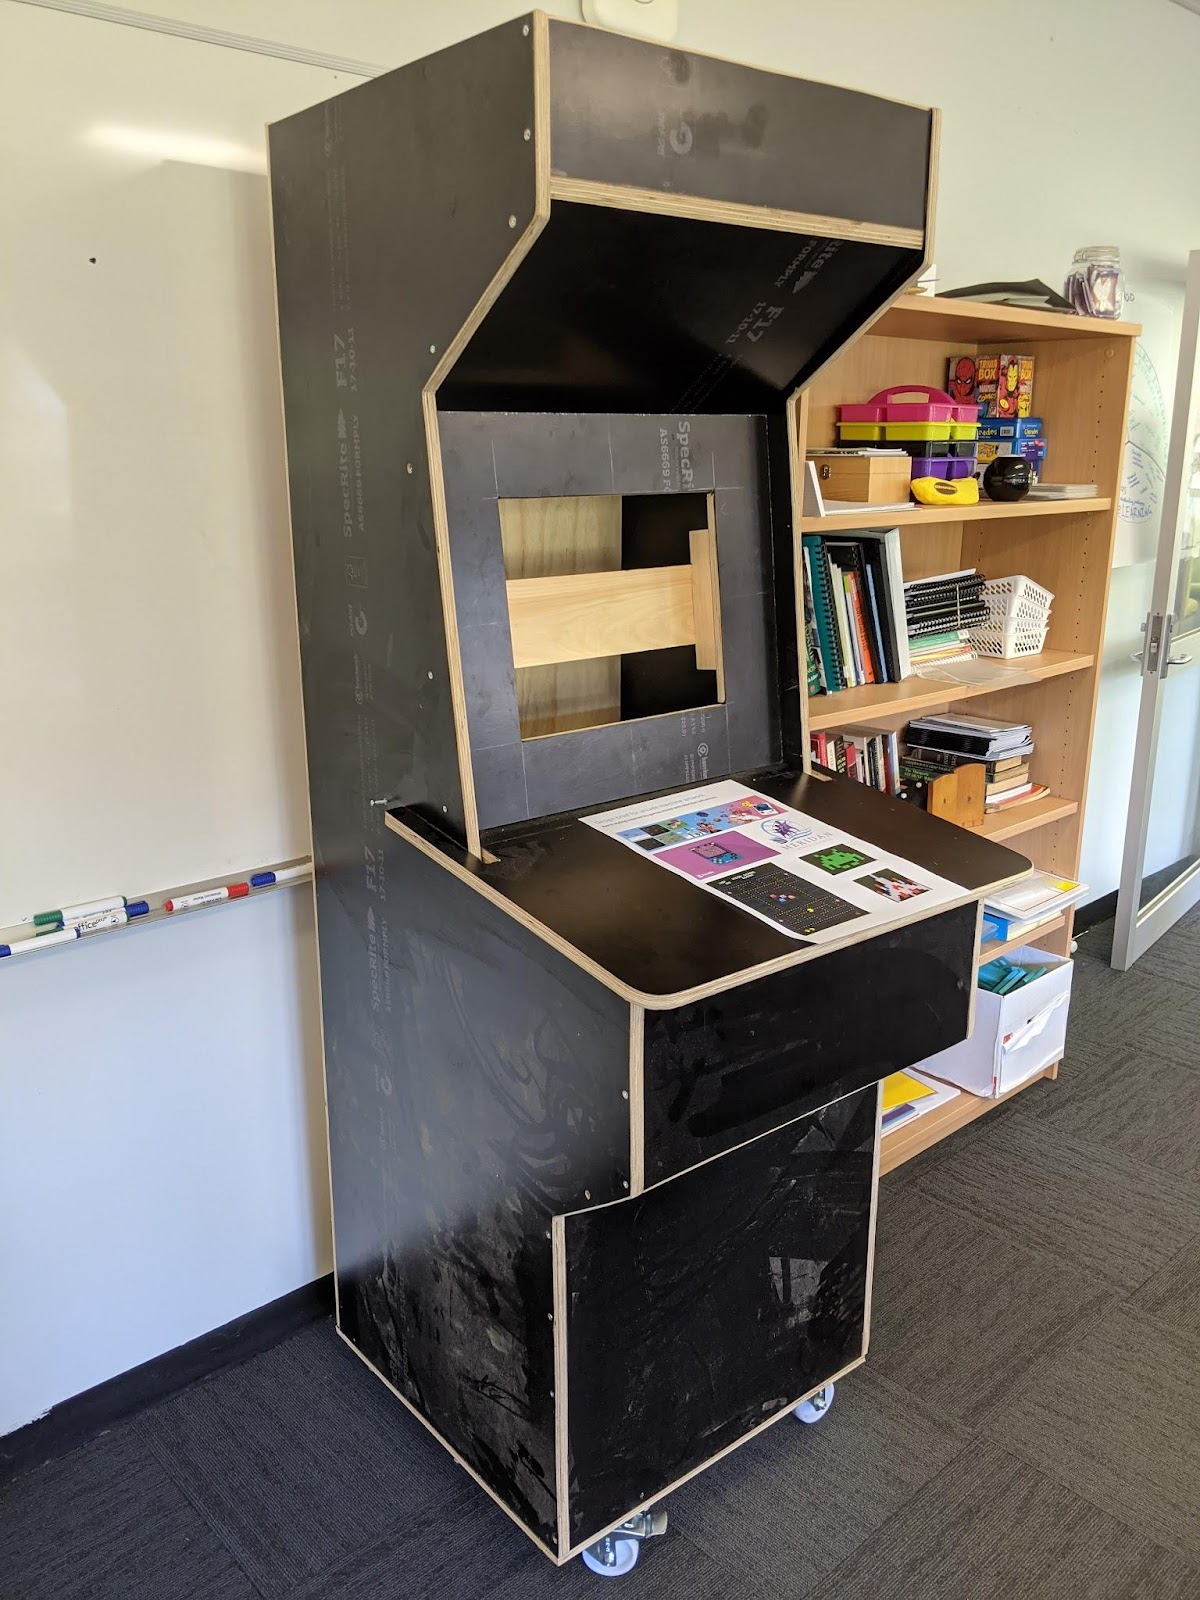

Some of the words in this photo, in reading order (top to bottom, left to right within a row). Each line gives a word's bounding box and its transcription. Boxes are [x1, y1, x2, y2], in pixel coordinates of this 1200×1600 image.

[334, 333, 347, 387] F17
[979, 369, 996, 380] BOX
[1021, 369, 1033, 380] BOX
[660, 428, 671, 477] AS6669
[339, 443, 353, 537] SpecRite
[364, 845, 377, 892] F17
[368, 933, 381, 1012] SpecRite
